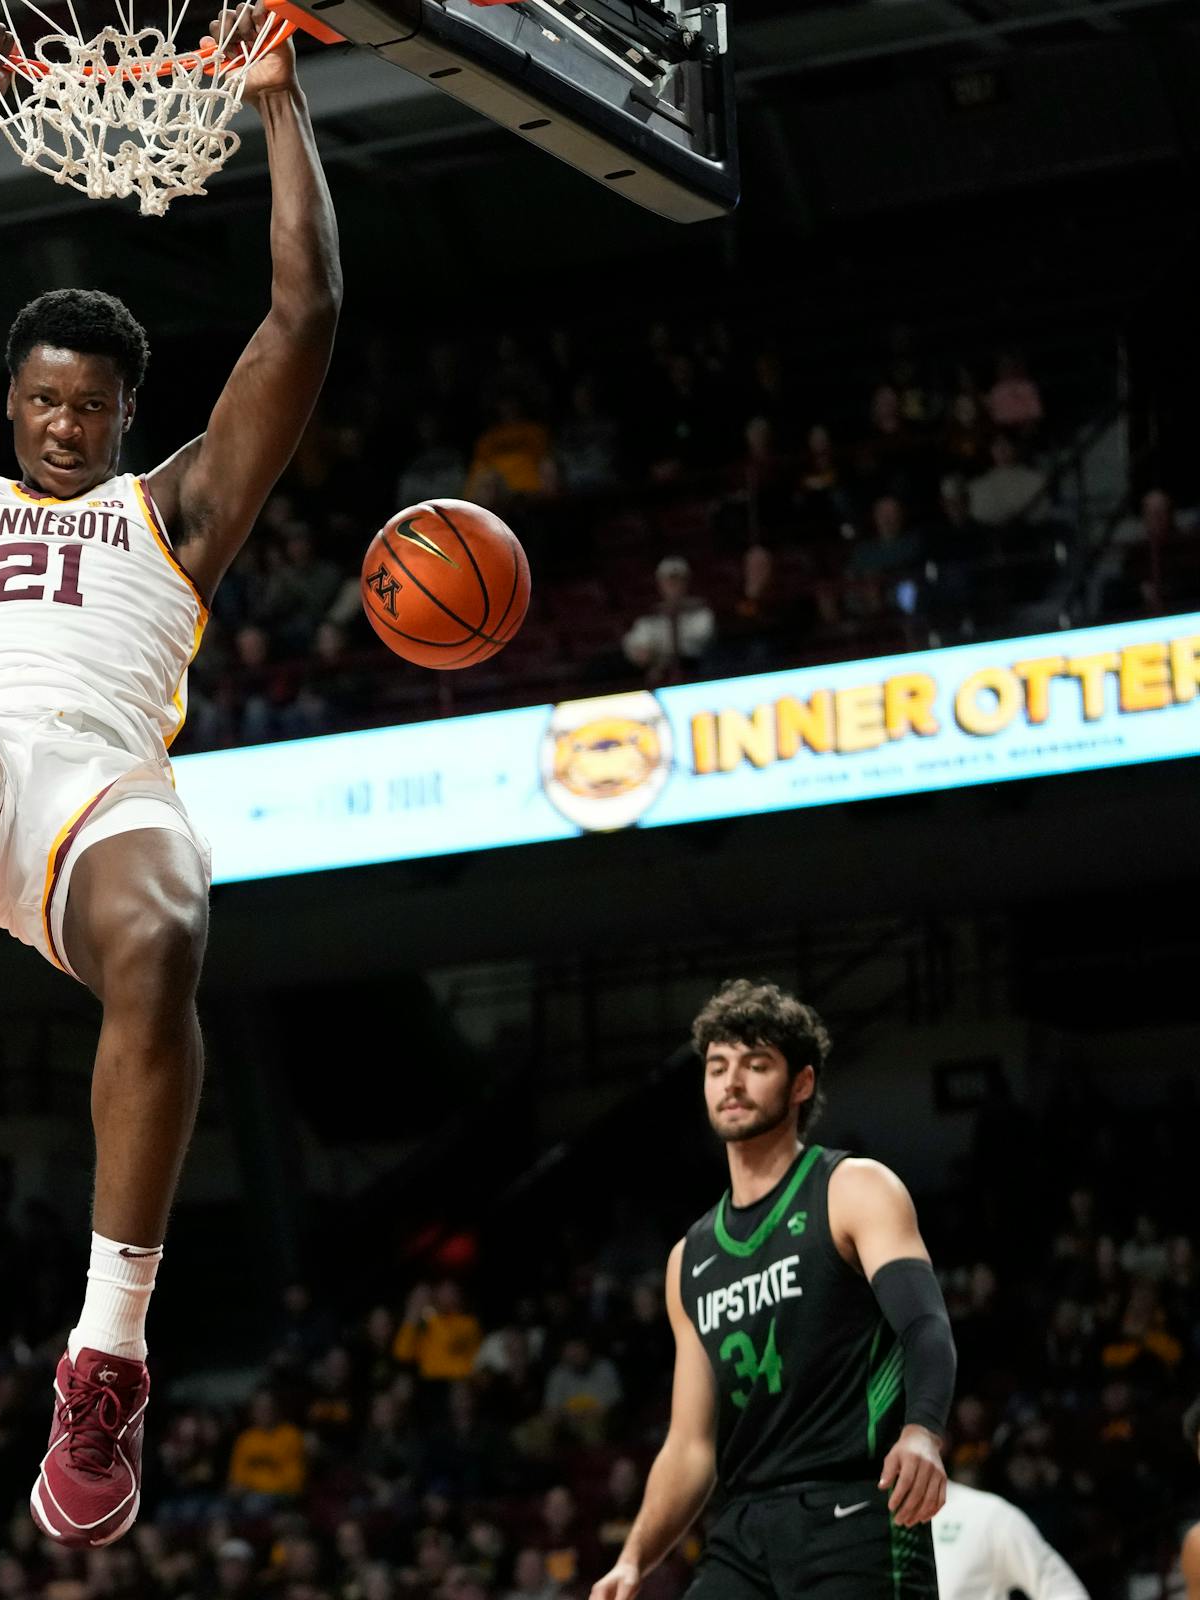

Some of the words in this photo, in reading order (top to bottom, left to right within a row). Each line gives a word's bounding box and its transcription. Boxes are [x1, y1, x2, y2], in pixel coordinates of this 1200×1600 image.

[691, 671, 939, 775] INNER
[697, 1255, 802, 1334] UPSTATE
[719, 1317, 783, 1408] 34
